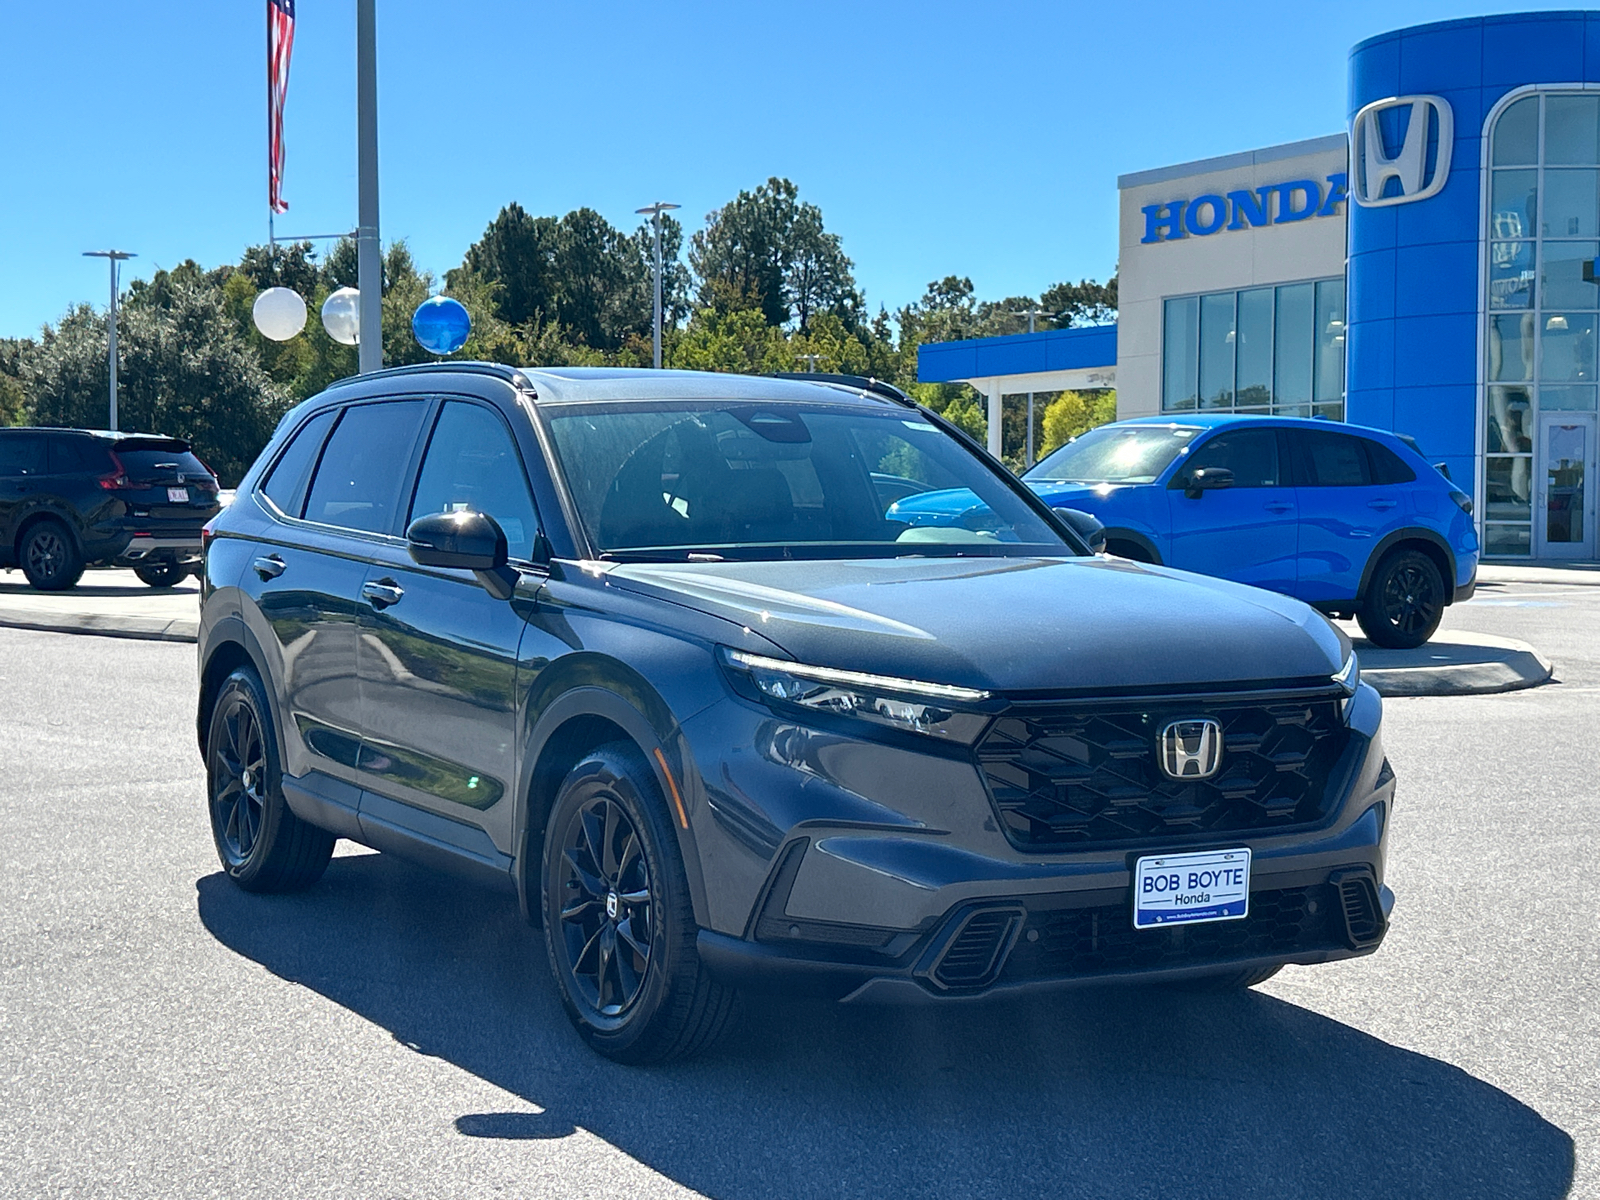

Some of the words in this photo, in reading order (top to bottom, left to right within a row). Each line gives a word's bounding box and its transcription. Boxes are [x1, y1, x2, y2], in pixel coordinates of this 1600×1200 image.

[1143, 874, 1180, 893] BOB
[1187, 868, 1244, 889] BOYTE
[1175, 892, 1211, 905] Honda
